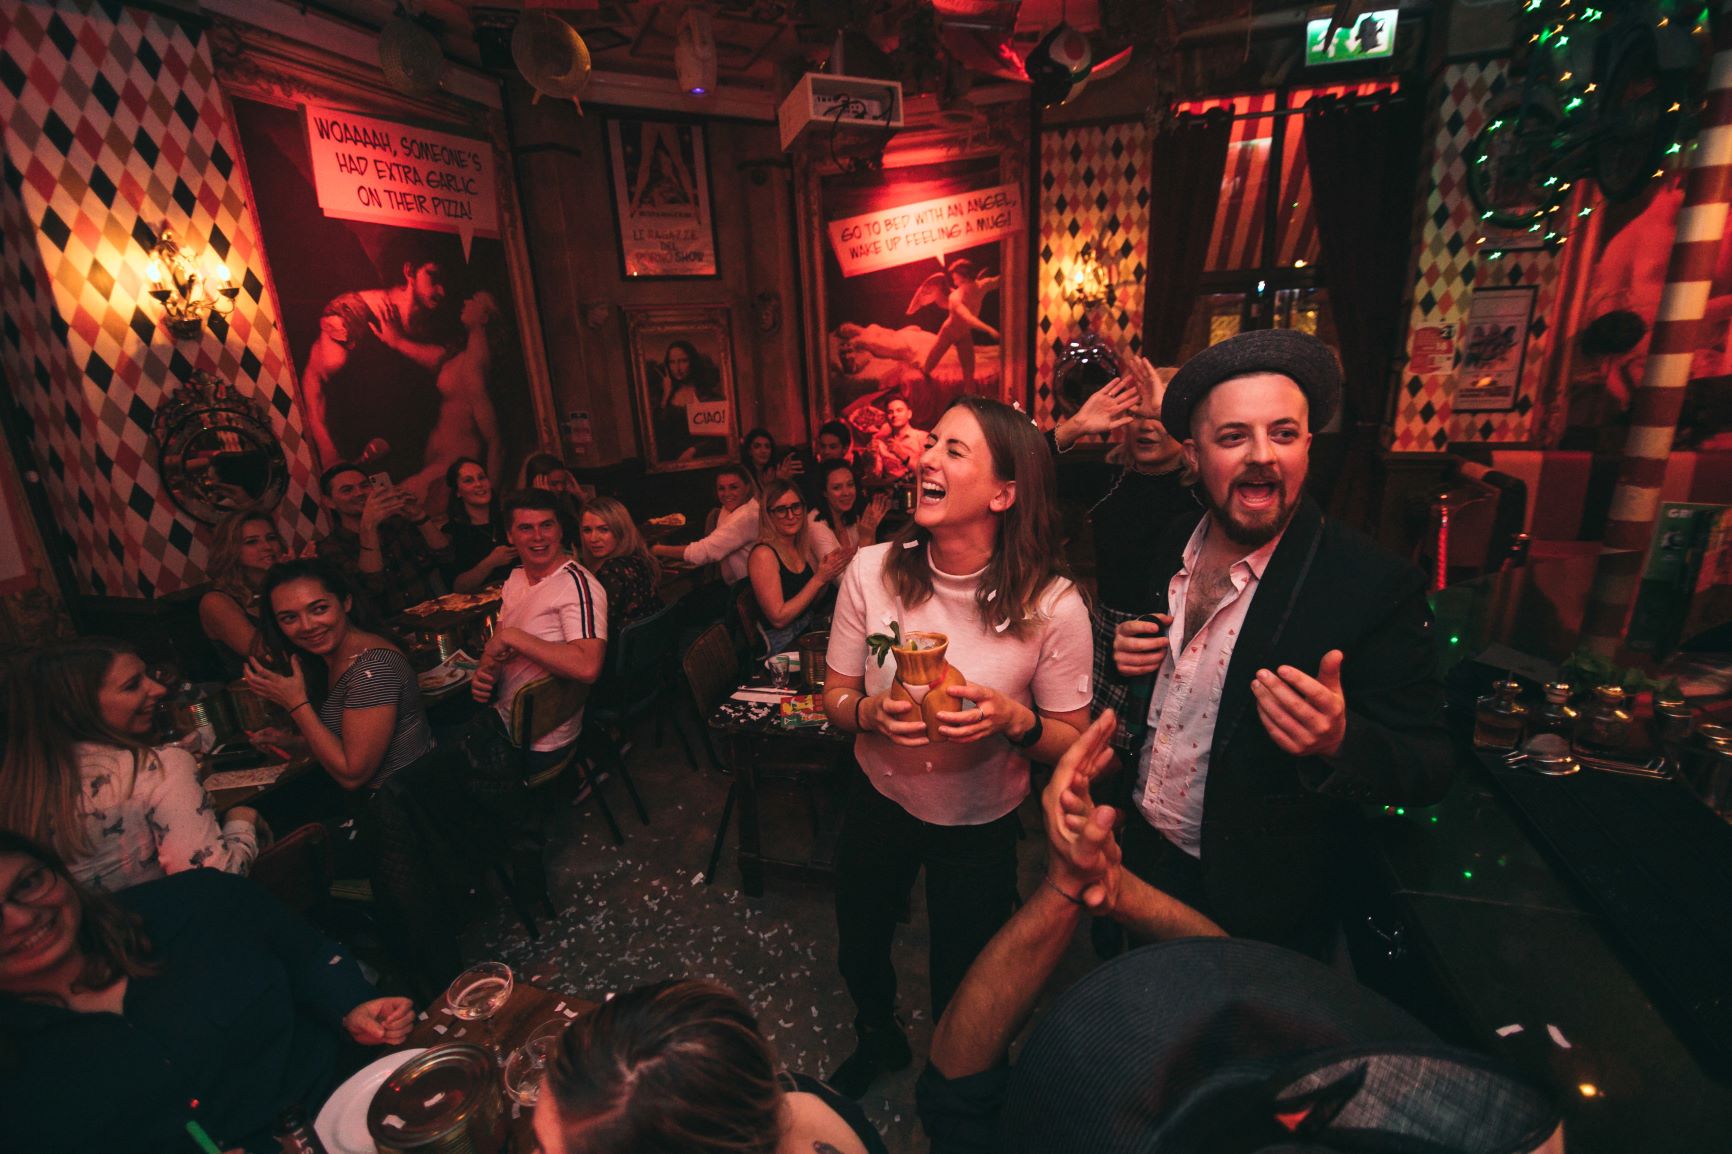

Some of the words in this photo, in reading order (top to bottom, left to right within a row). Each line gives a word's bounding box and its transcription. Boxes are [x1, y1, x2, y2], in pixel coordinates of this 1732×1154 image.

[401, 136, 482, 171] SOMEONE'S
[335, 152, 368, 176] HAD
[374, 160, 424, 187] EXTRA
[427, 170, 478, 196] GARLIC
[357, 185, 383, 209] ON
[384, 189, 430, 214] THEIR
[432, 197, 473, 220] PIZZA!
[841, 226, 862, 242] GO
[865, 221, 881, 237] TO
[884, 214, 911, 232] BED
[915, 207, 944, 226] WITH
[946, 203, 965, 219] AN
[967, 192, 1017, 212] ANGEL,
[849, 240, 882, 260] WAKE
[885, 235, 902, 251] UP
[905, 224, 962, 247] FEELING
[965, 220, 974, 235] A
[976, 210, 1012, 231] MUG!
[675, 251, 705, 263] SHOW
[693, 409, 726, 425] CIAO!
